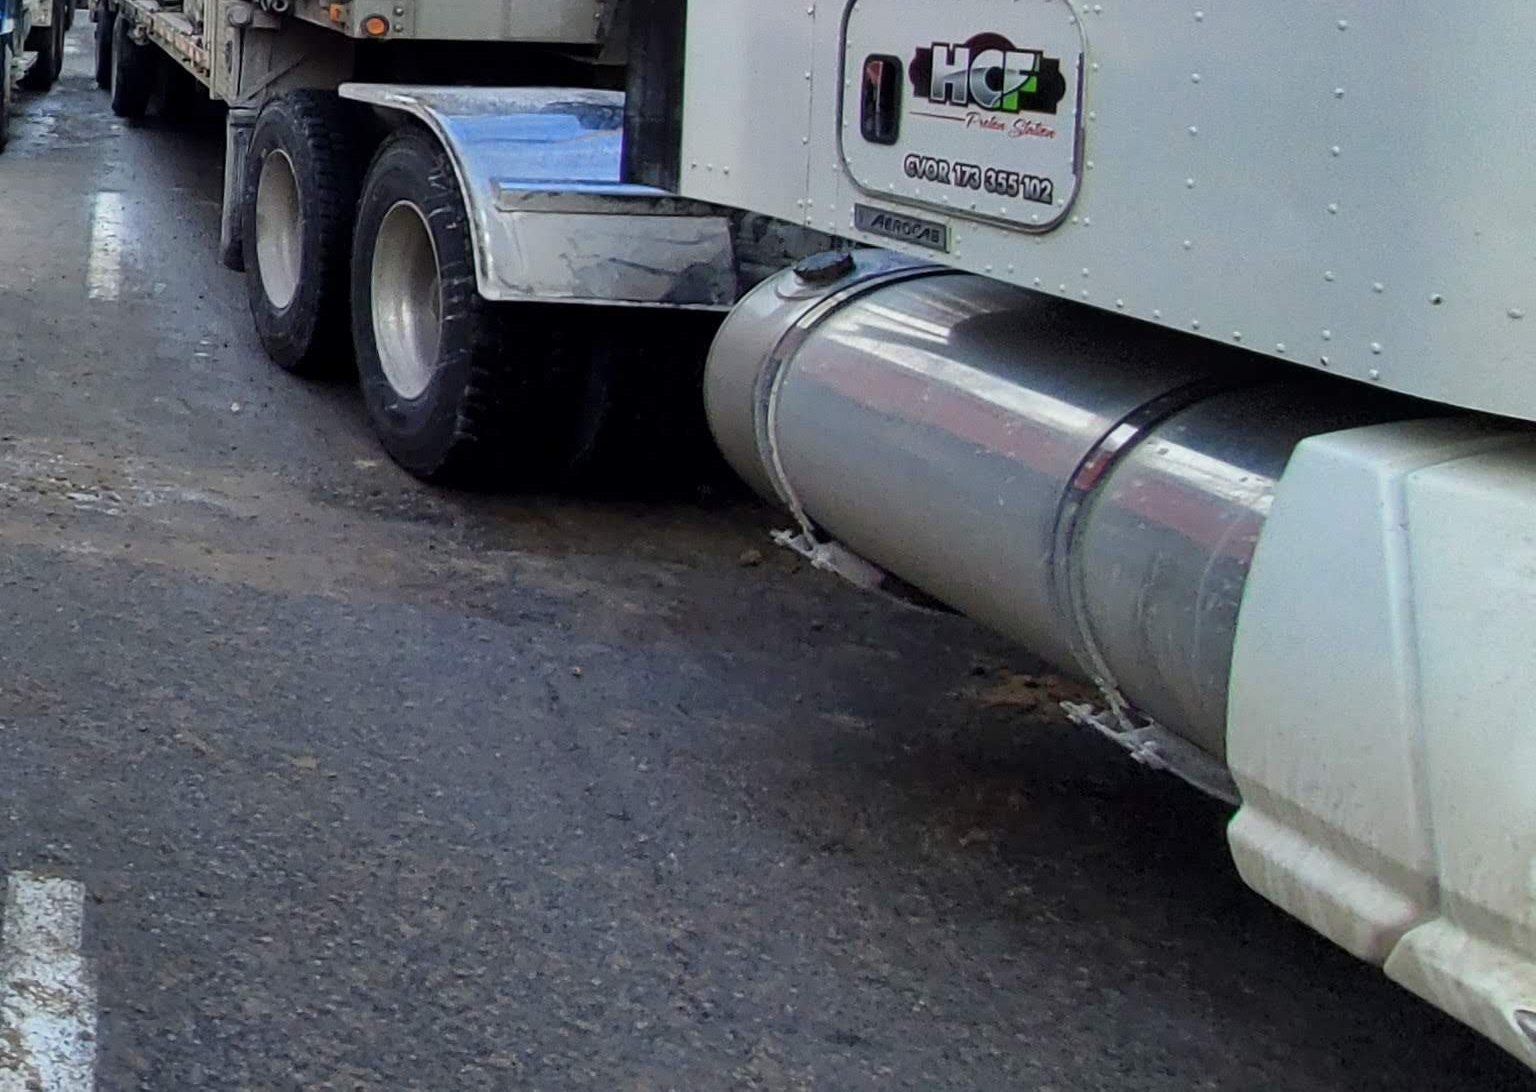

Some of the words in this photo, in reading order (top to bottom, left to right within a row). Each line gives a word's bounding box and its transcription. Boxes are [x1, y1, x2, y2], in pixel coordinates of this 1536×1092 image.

[904, 153, 950, 185] CVOR
[953, 162, 981, 190] 173
[984, 168, 1019, 197] 355
[1022, 174, 1053, 205] 102
[870, 213, 940, 244] AEROCAB
